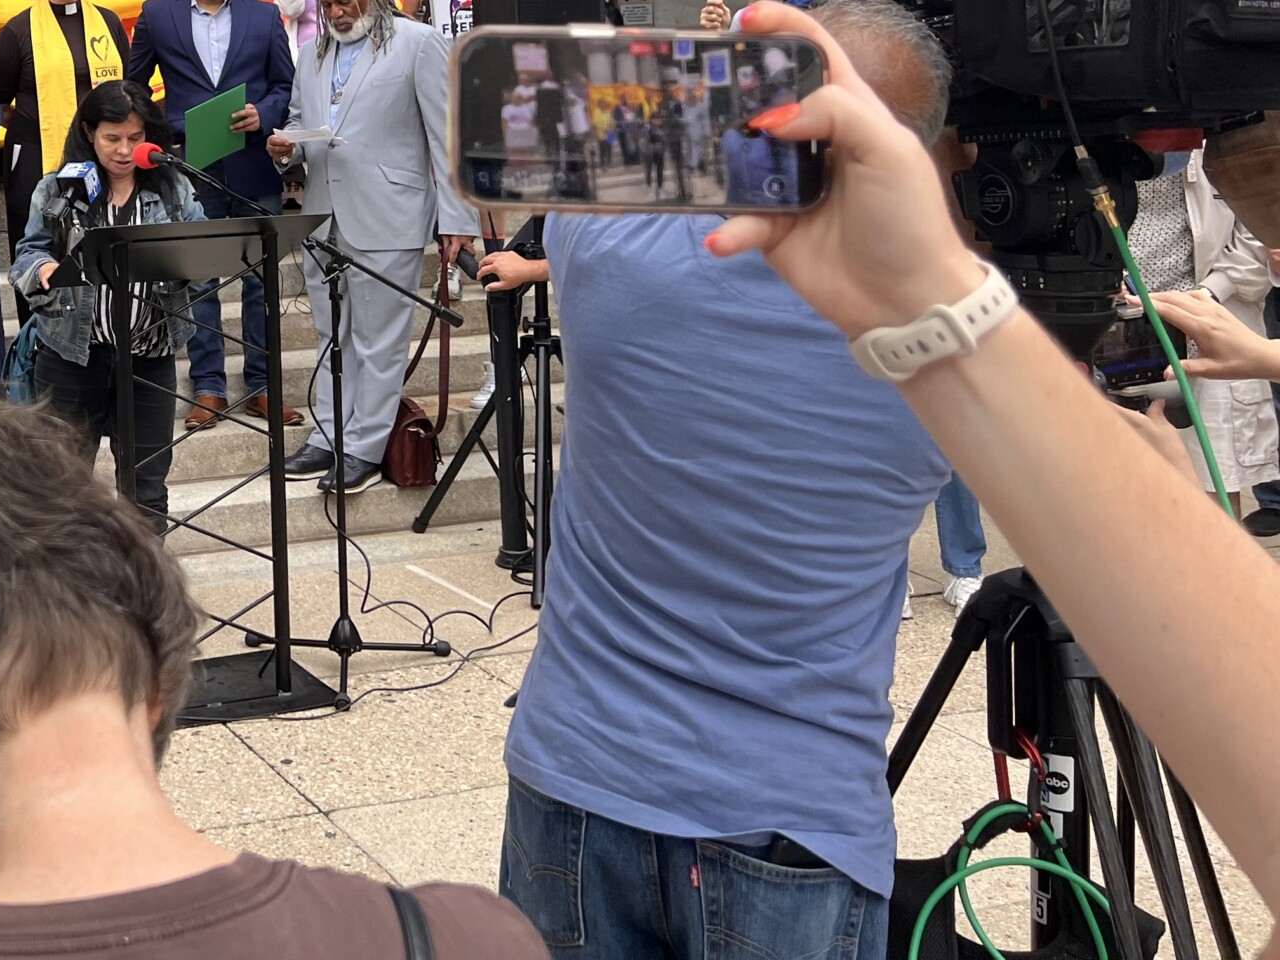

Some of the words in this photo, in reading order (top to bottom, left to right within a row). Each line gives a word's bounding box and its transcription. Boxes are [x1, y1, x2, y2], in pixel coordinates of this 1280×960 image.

[95, 68, 118, 78] LOVE
[1045, 777, 1069, 789] abc
[1035, 899, 1044, 920] 5
